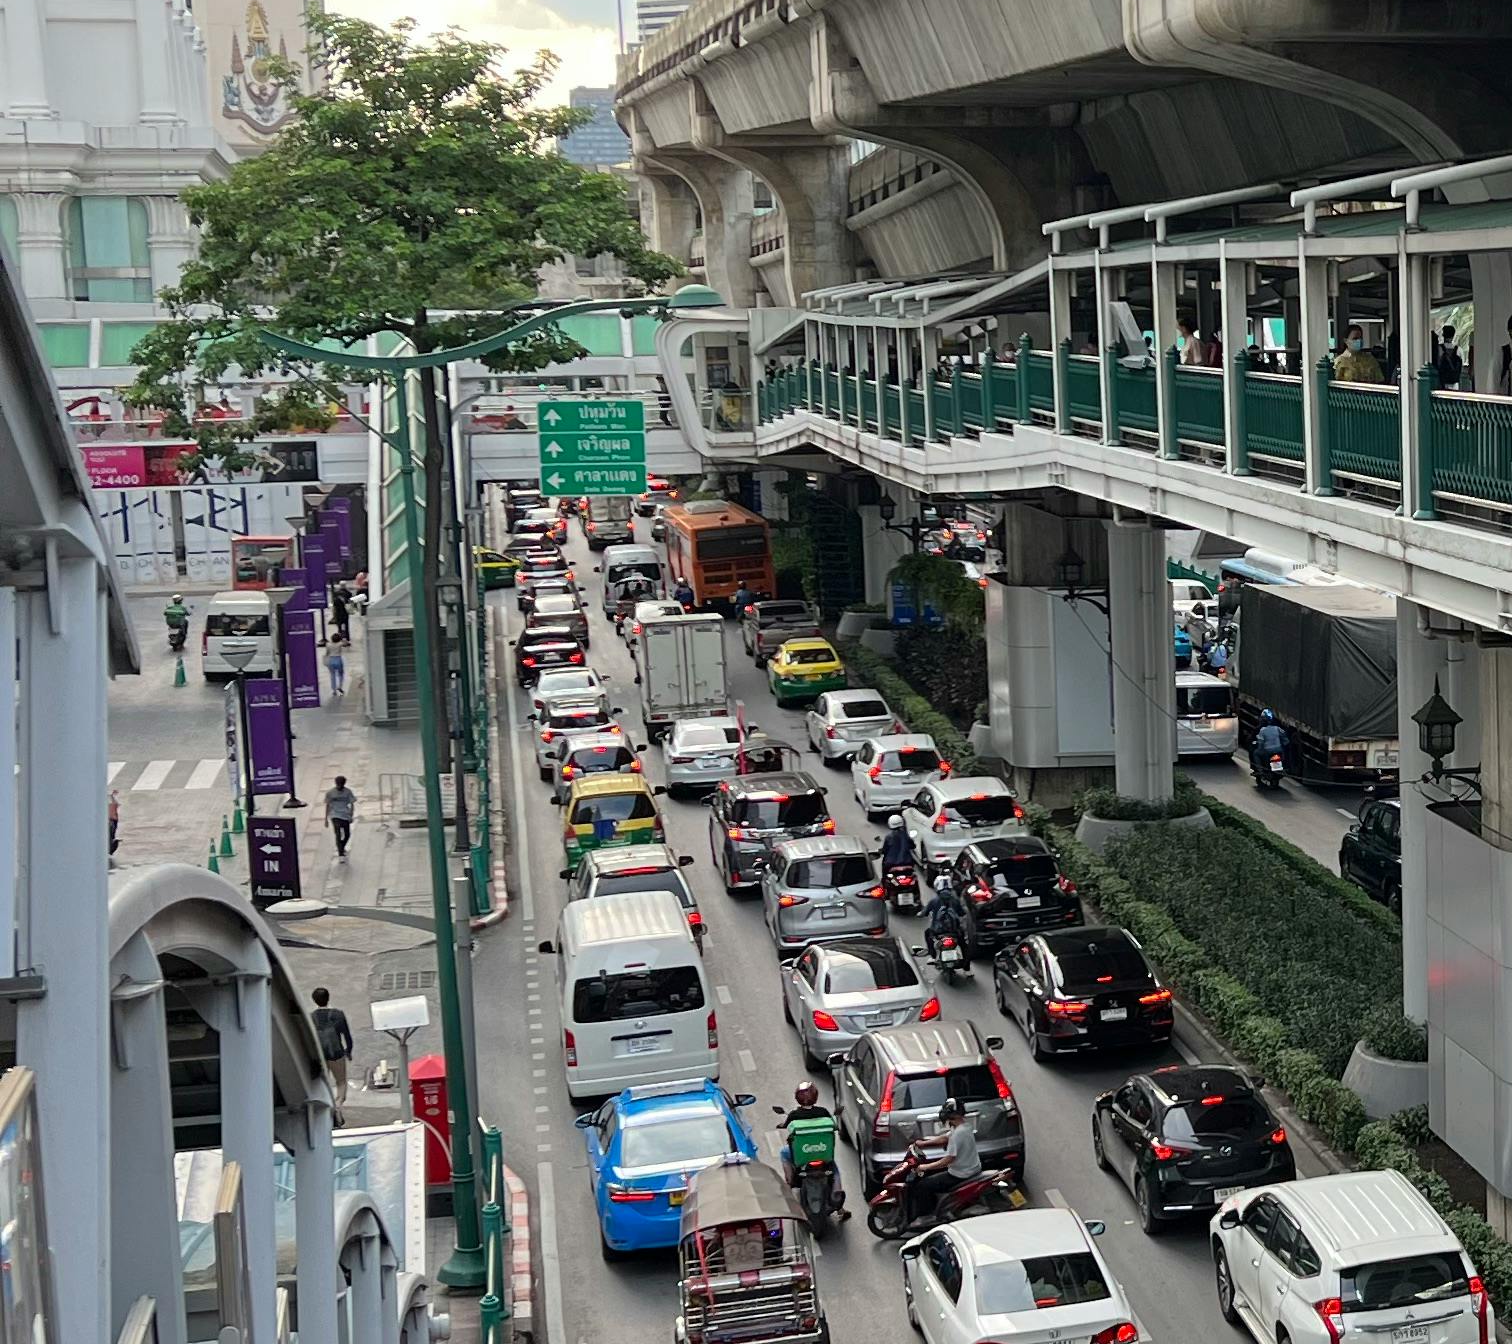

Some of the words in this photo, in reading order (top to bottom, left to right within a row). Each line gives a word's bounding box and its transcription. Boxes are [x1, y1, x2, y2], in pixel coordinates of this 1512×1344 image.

[578, 402, 627, 423] ปทุมวัน
[577, 435, 631, 453] เจริญผล
[574, 470, 637, 482] ศาลาแดง
[263, 859, 280, 873] IN
[801, 1141, 828, 1154] Grab
